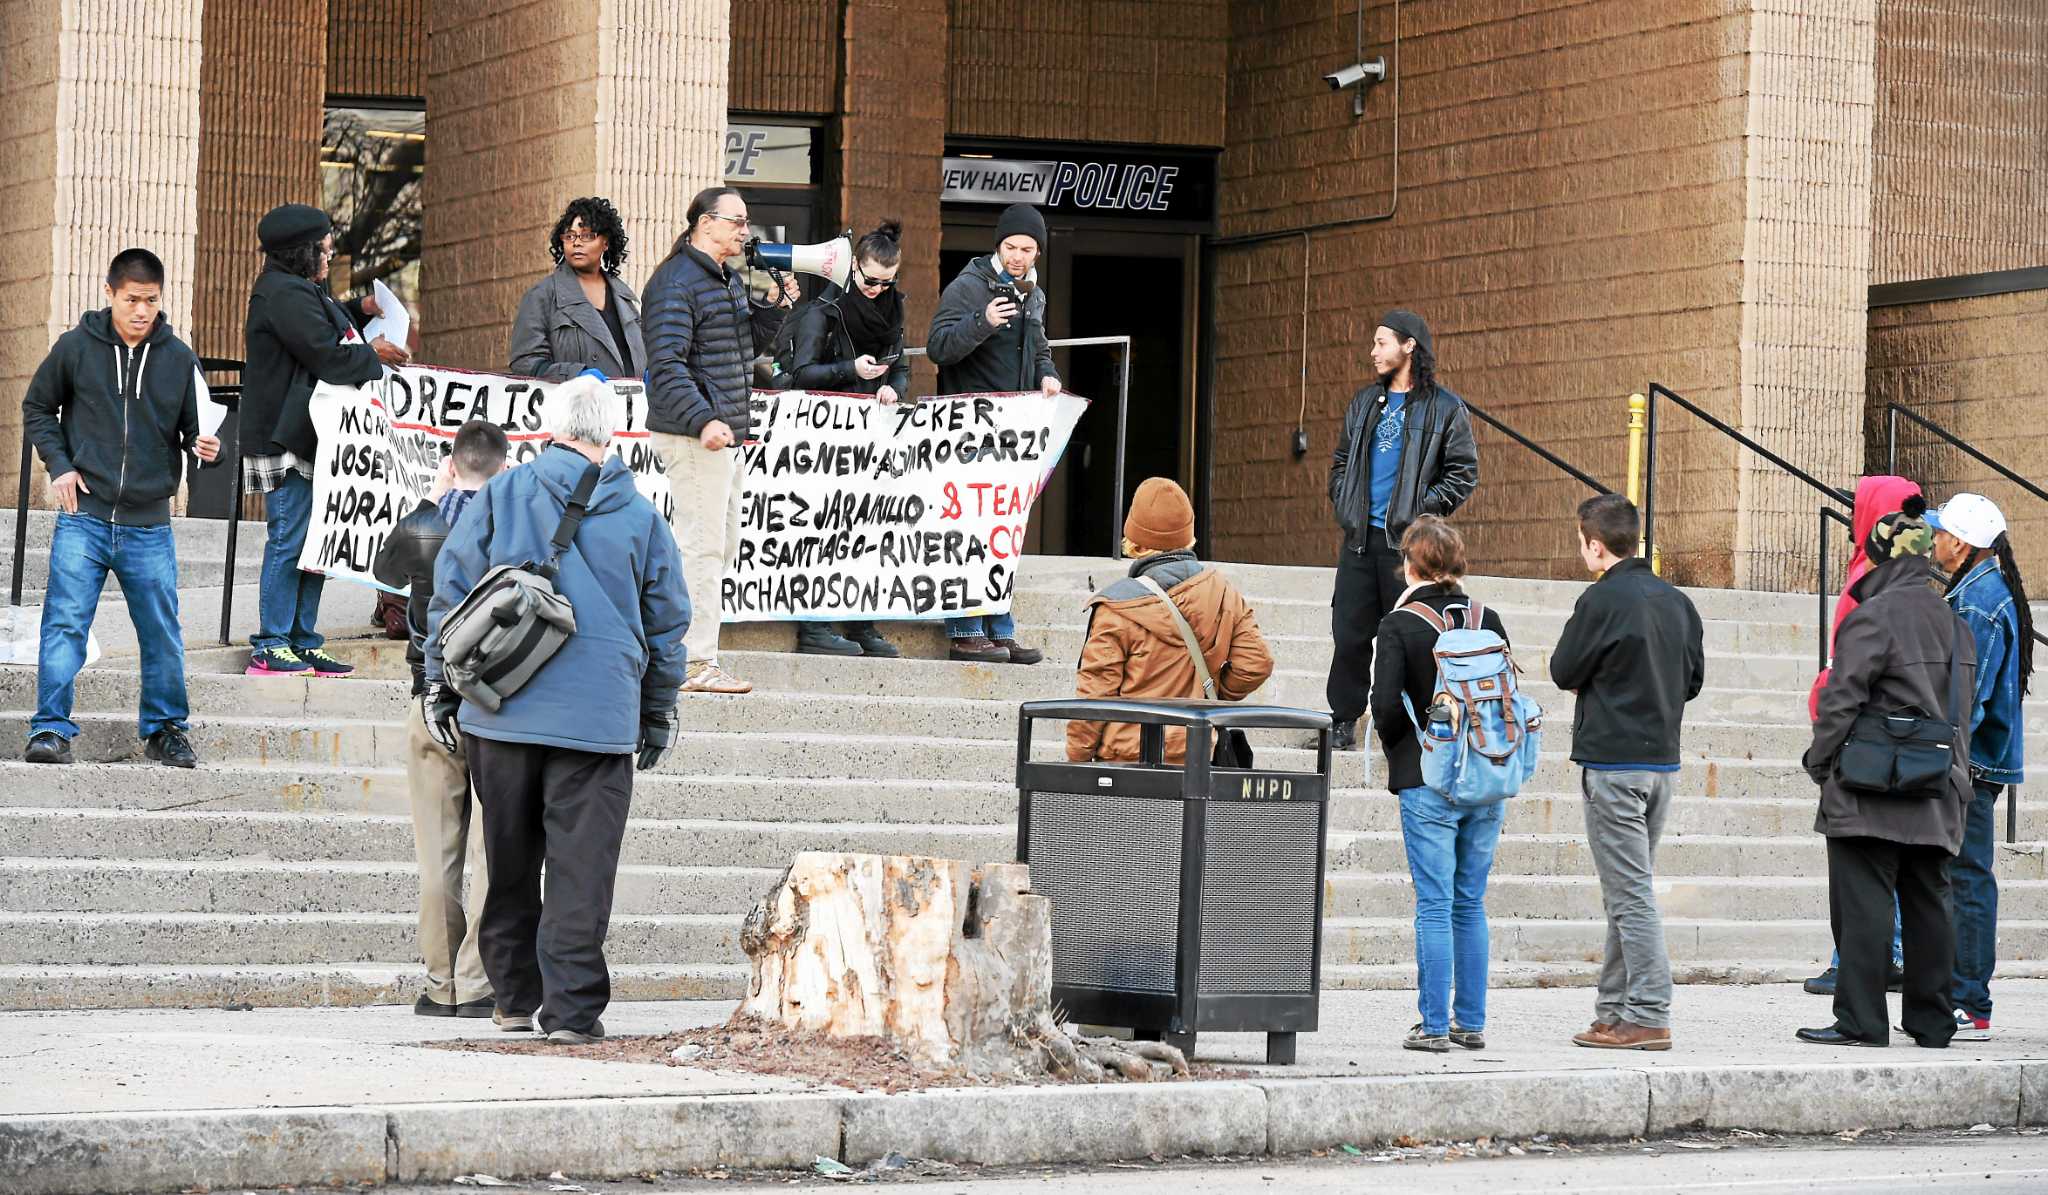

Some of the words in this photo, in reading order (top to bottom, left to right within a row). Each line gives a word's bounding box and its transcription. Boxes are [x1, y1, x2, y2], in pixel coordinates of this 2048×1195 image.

[981, 171, 1047, 193] HAVEN
[1049, 161, 1179, 211] POLICE
[499, 382, 545, 432] IS
[795, 399, 871, 430] HOLLY
[893, 398, 995, 437] TCKER
[735, 445, 767, 475] YA
[773, 440, 875, 478] AGNEW
[721, 571, 880, 614] RICHARDSON
[887, 574, 982, 614] ABEL
[1242, 778, 1292, 800] NHPD
